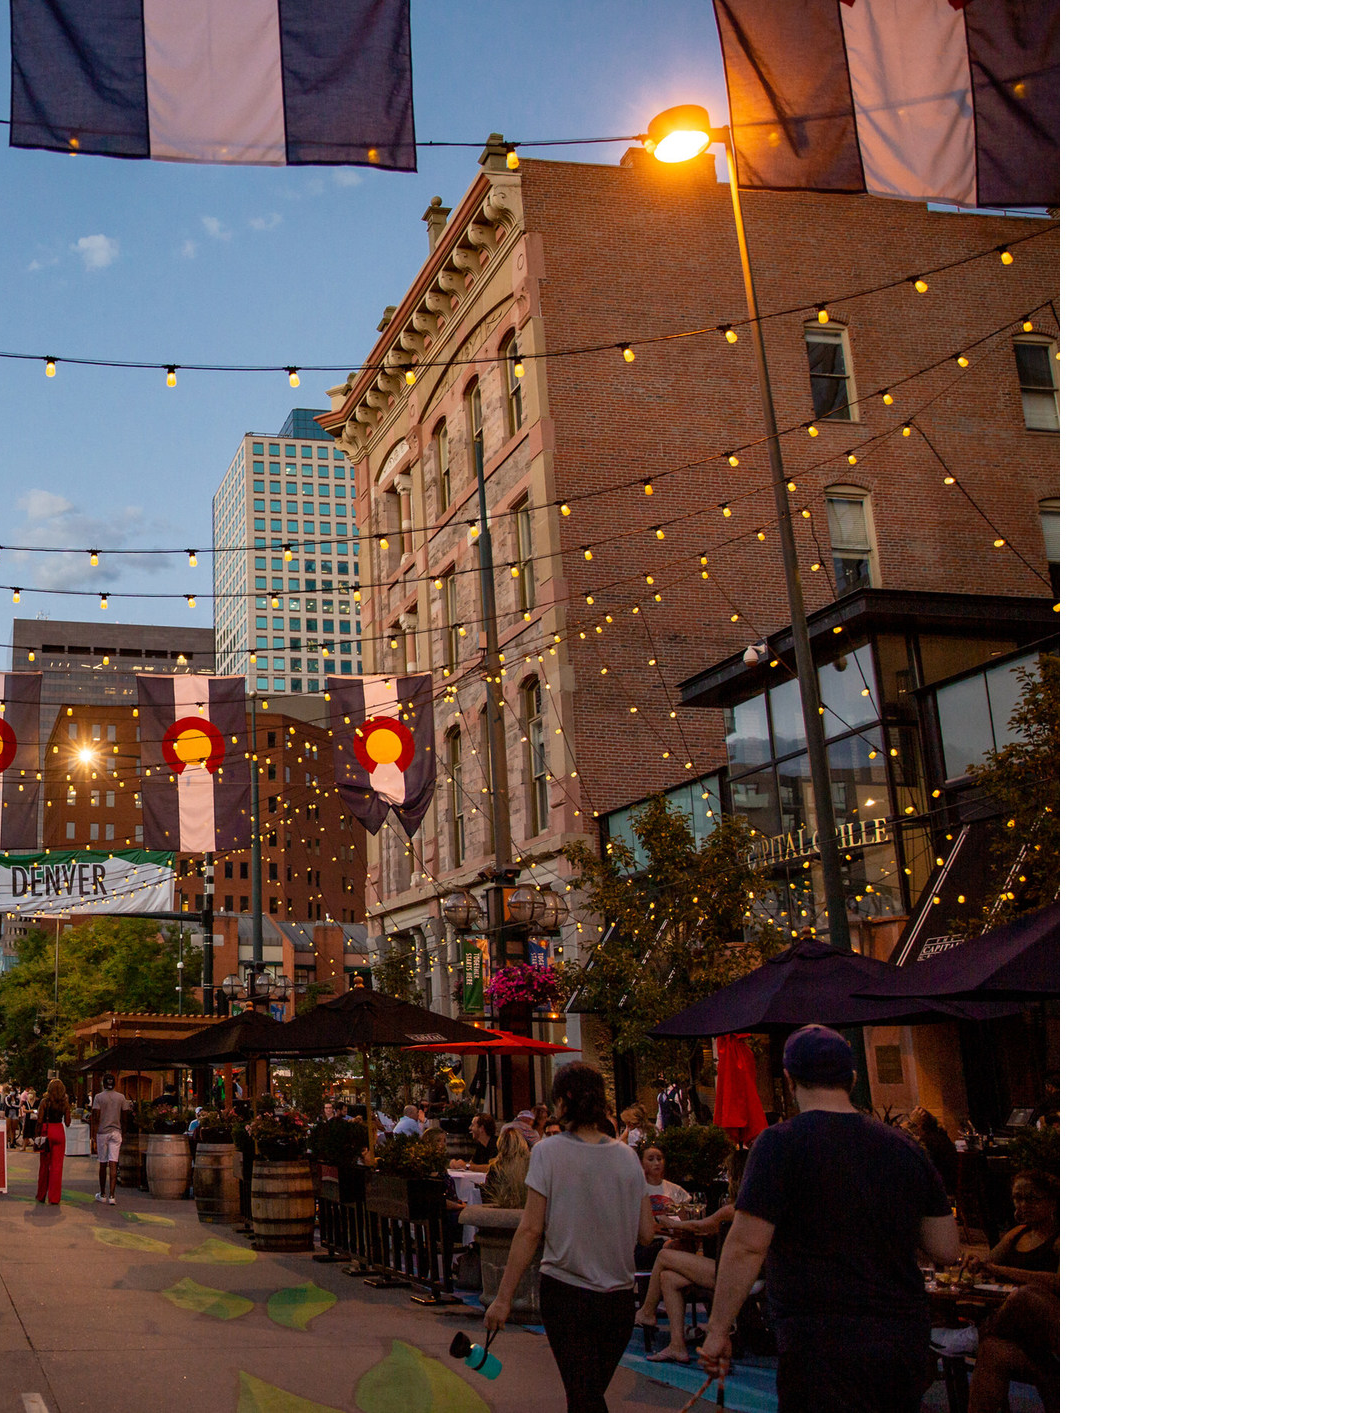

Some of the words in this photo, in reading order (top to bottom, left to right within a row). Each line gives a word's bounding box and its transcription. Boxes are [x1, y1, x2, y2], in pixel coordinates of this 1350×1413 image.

[11, 863, 107, 897] DENVER
[923, 942, 959, 953] CAPITA
[465, 972, 473, 985] HERE
